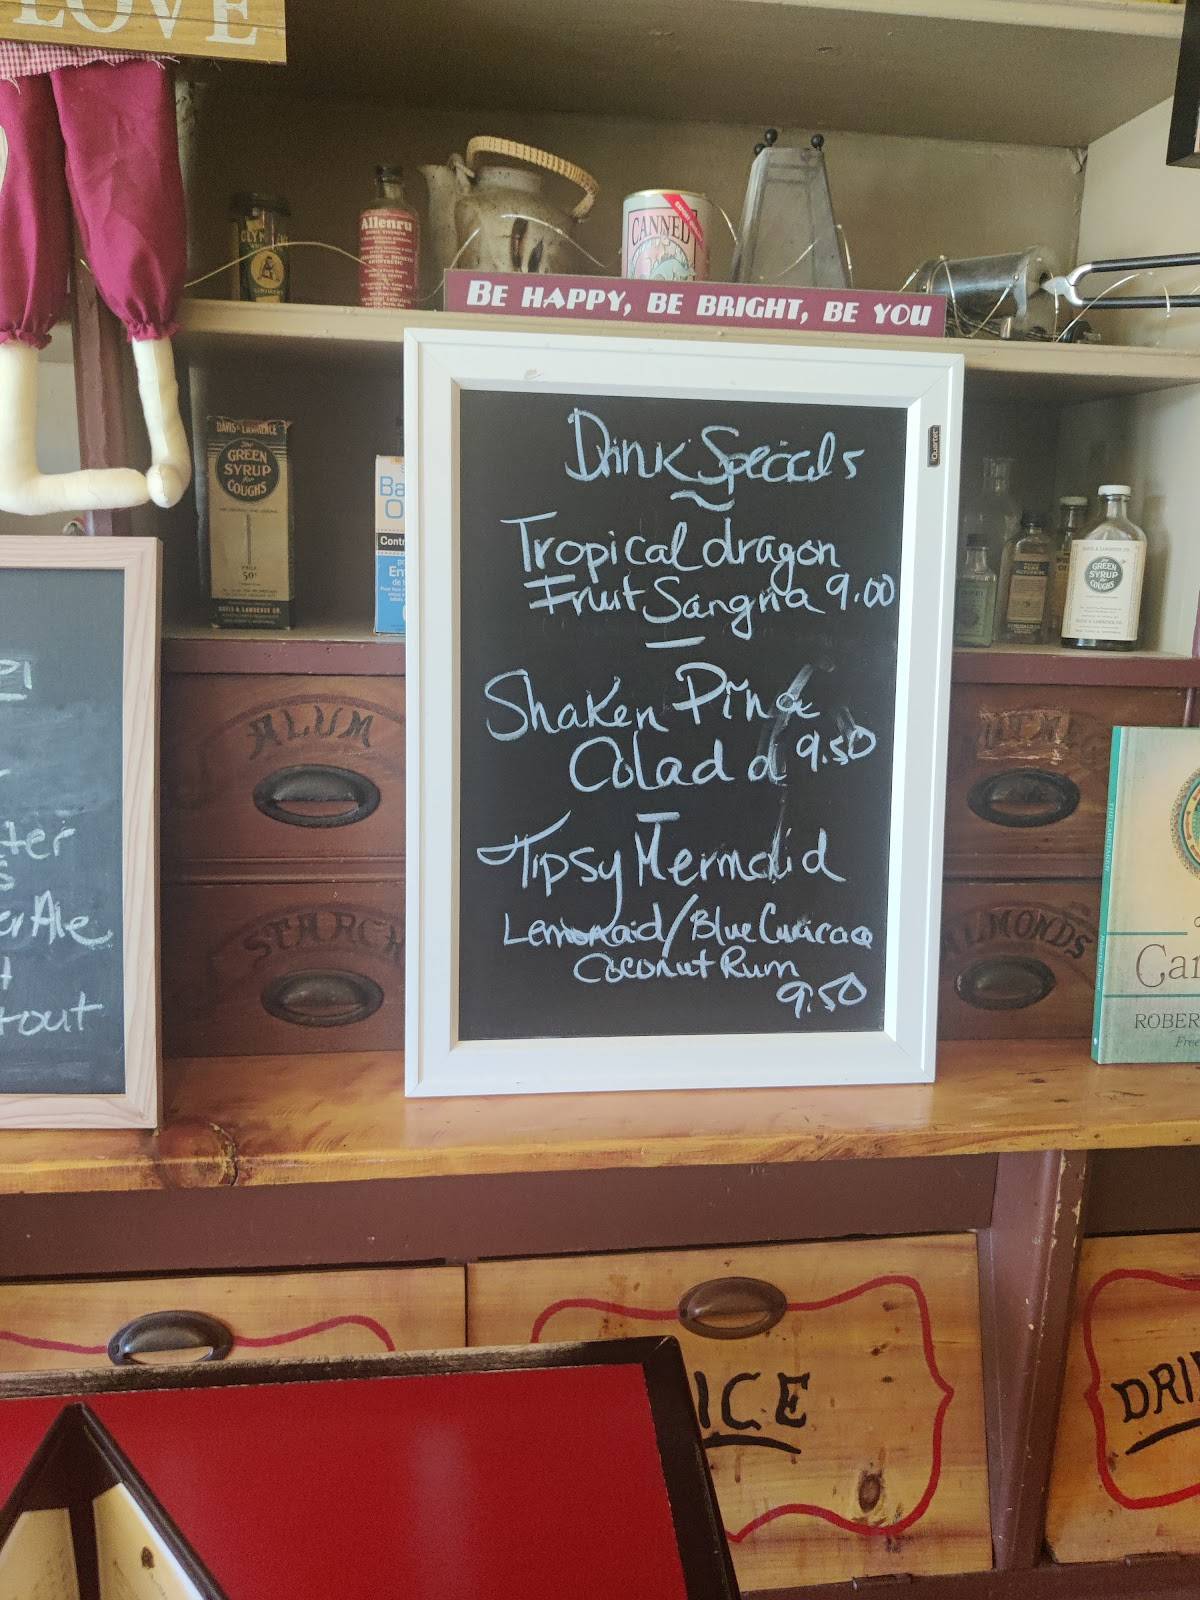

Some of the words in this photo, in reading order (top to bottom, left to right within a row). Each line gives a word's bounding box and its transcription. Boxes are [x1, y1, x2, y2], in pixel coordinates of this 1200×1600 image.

[12, 0, 258, 45] LOVE
[361, 216, 412, 232] Allenru
[631, 215, 691, 246] CANNED
[521, 286, 632, 317] HAPPY,
[647, 292, 684, 315] BE
[696, 294, 809, 325] BRIGHT,
[822, 300, 859, 323] BE
[873, 302, 932, 327] YOU
[227, 448, 268, 464] GREEN
[564, 407, 697, 483] Drink
[223, 463, 272, 477] SYRUP
[227, 479, 268, 497] COUGHS
[501, 511, 702, 583] Tropical
[702, 517, 840, 596] dragon
[1091, 562, 1118, 571] GREEN
[1089, 570, 1119, 579] SYRUP
[1090, 579, 1116, 590] COUGHS
[523, 570, 646, 615] Fruit
[642, 575, 826, 640] Sangria
[825, 572, 894, 611] 9.00
[484, 668, 669, 742] Shaken
[249, 704, 374, 760] ALUM
[635, 812, 847, 888] Mermaid
[573, 948, 717, 984] Coconut
[719, 945, 800, 979] Rum
[776, 972, 867, 1019] 9.50
